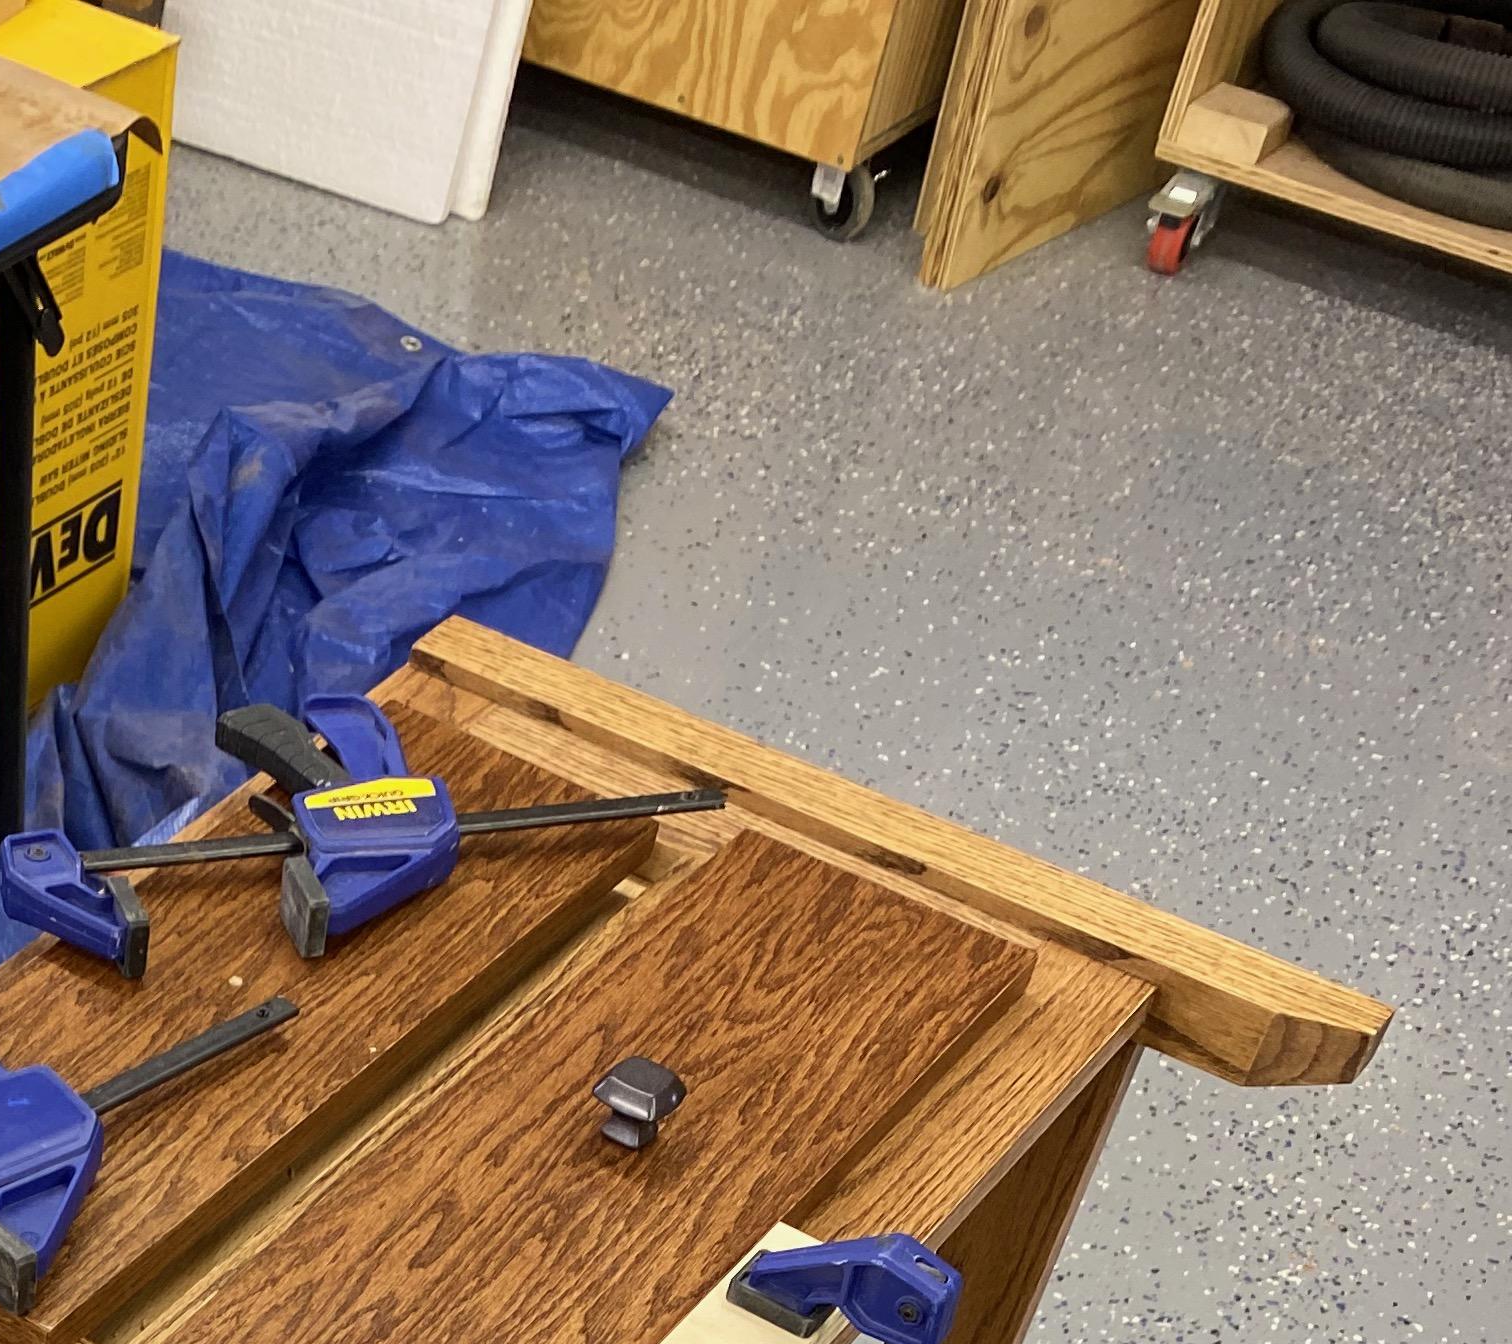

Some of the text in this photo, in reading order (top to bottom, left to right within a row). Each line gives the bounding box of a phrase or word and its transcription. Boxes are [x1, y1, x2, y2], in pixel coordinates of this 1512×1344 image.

[122, 306, 139, 322] 305
[102, 316, 120, 331] mm
[71, 353, 84, 370] ET
[49, 353, 114, 397] COULISSANTE
[106, 376, 119, 391] 12
[121, 367, 134, 383] DE
[76, 384, 133, 426] DESLIZANTE
[98, 401, 131, 427] SIERRA
[61, 419, 74, 433] DE
[39, 427, 128, 487] SLIDING MITER SAW
[332, 799, 418, 821] IRWIN
